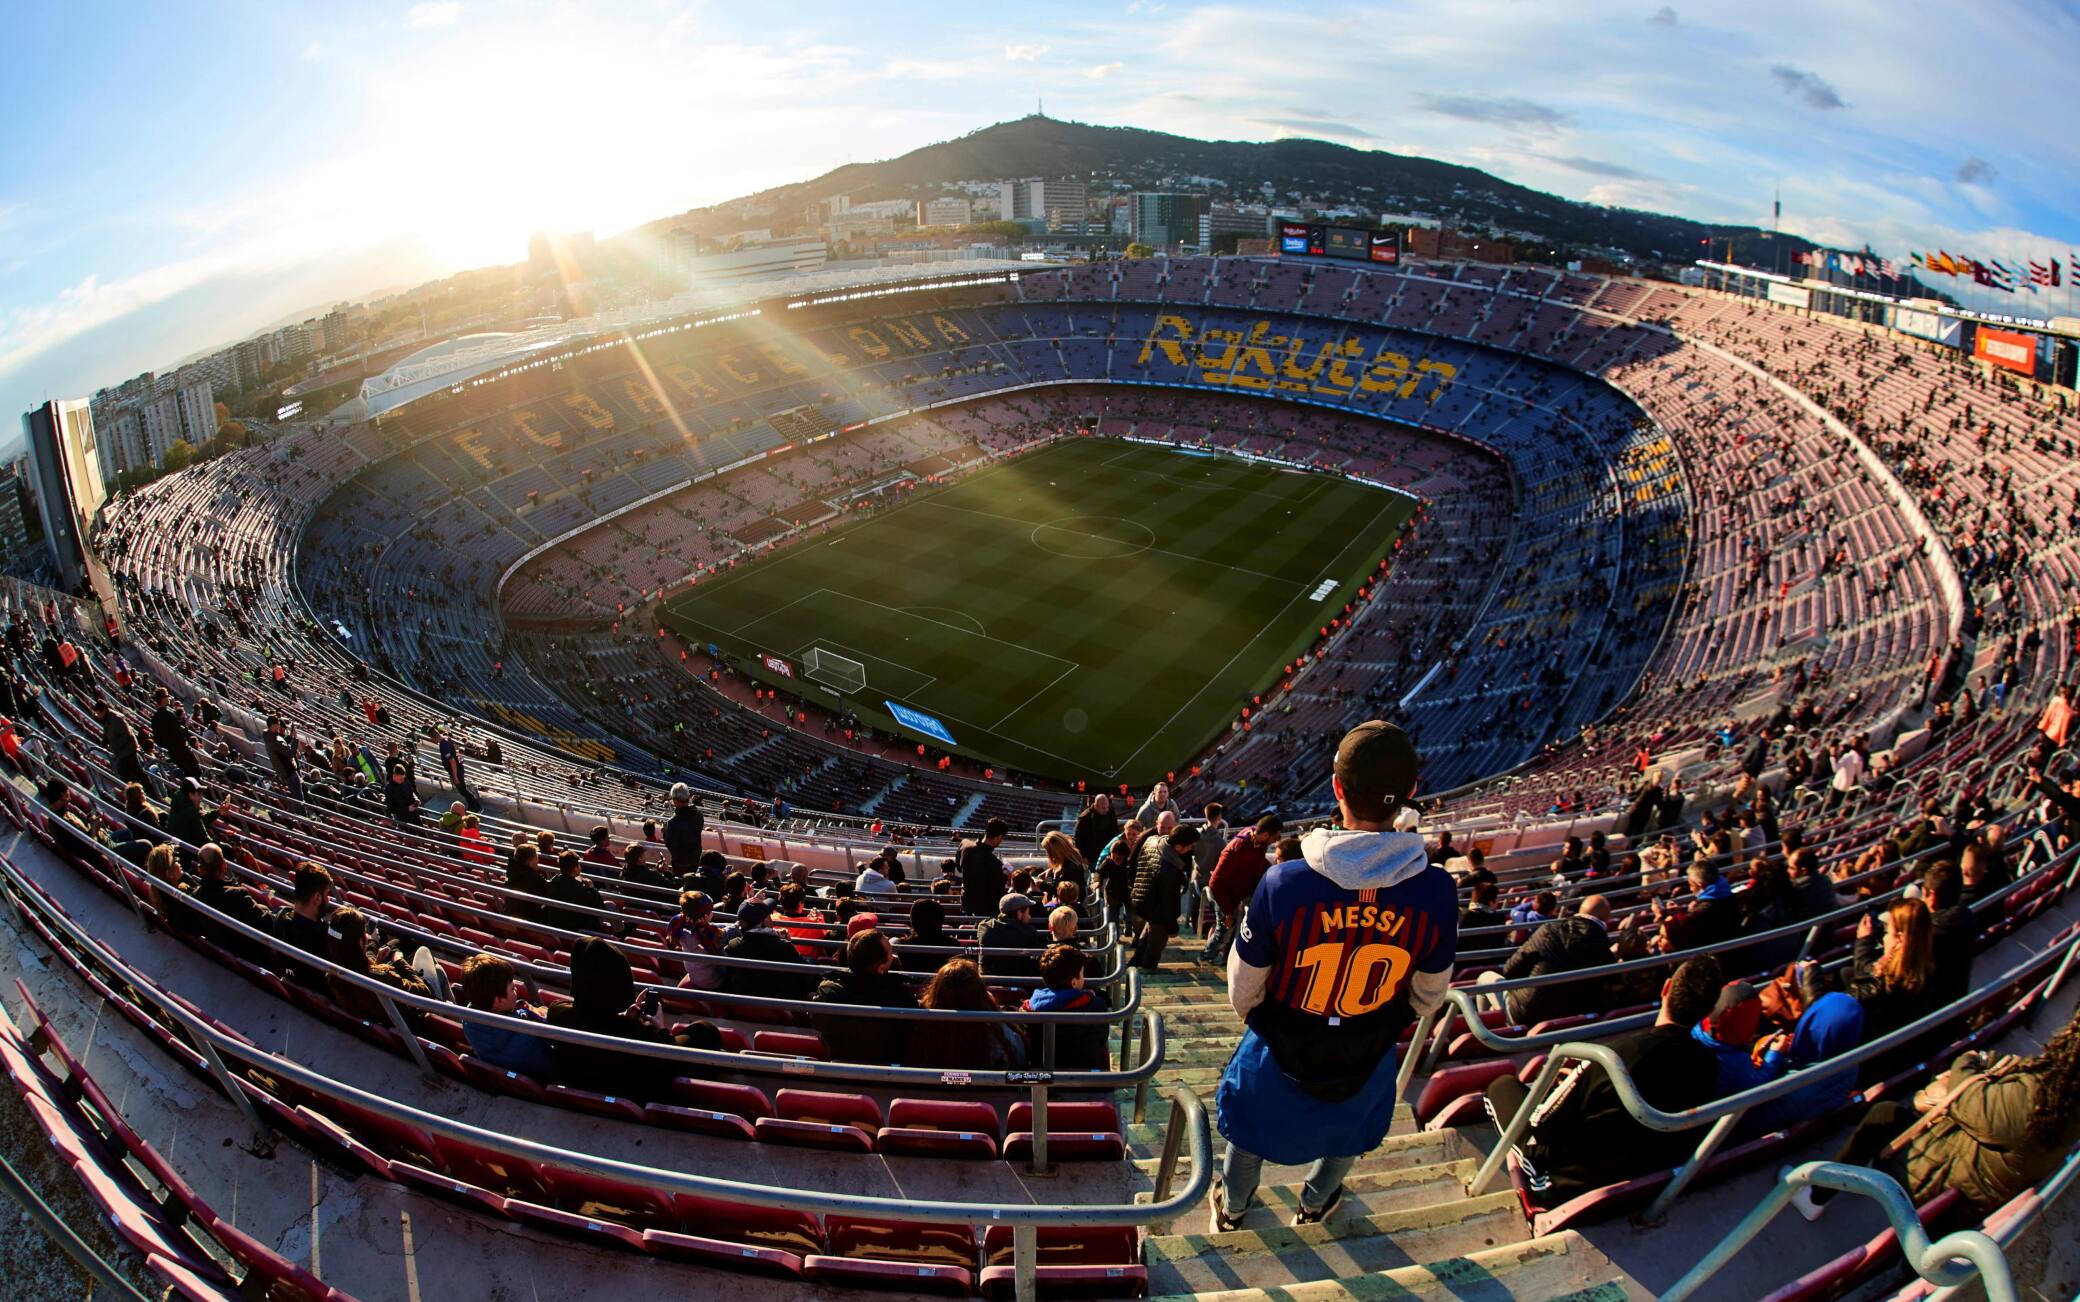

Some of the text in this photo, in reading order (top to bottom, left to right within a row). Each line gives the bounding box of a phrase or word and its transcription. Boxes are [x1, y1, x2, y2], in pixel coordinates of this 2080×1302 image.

[1137, 315, 1457, 404] Rakuten
[1321, 906, 1406, 937] MESSI
[1295, 943, 1411, 1017] 10
